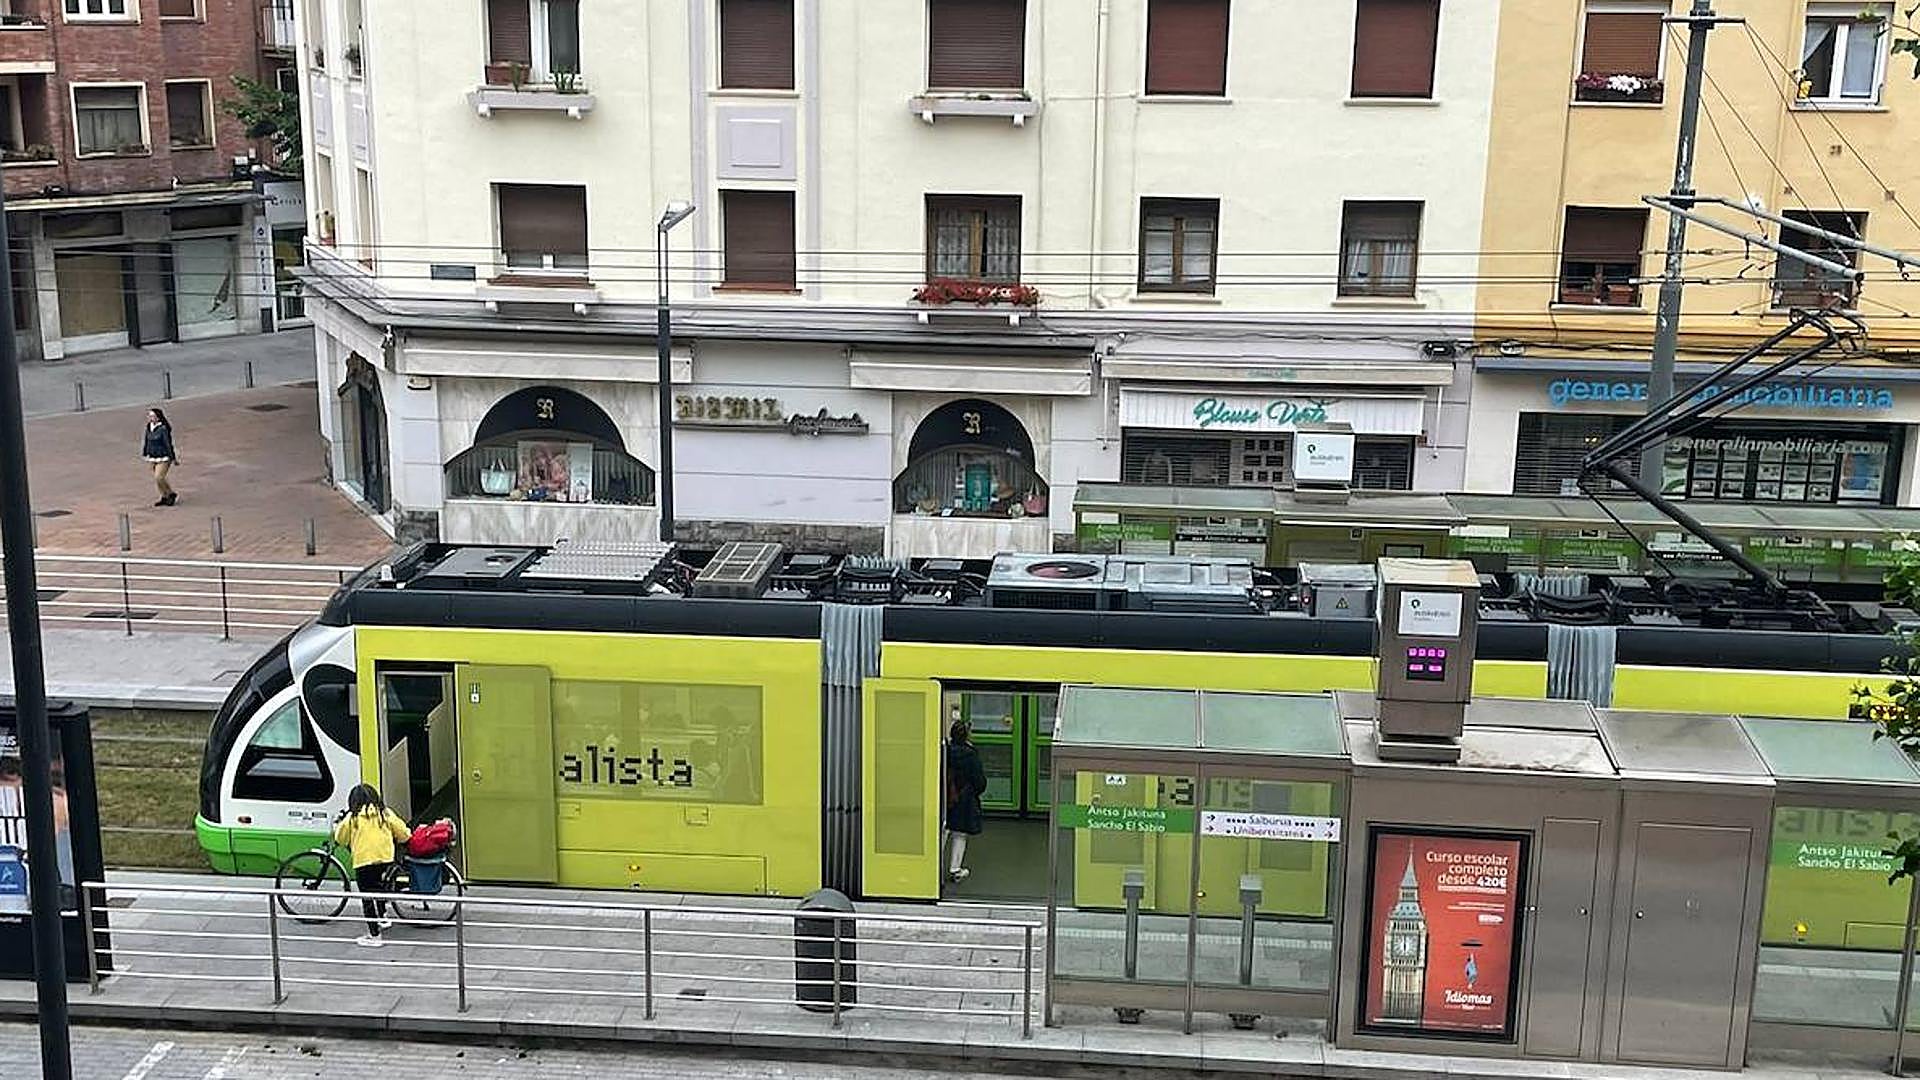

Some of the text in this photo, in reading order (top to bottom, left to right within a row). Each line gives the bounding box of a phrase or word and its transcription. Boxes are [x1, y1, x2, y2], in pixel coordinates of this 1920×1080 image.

[1550, 377, 1649, 406] gener
[560, 745, 692, 787] alista
[1088, 805, 1120, 816] Antso
[1088, 819, 1166, 832] Sancho El Sabio
[1799, 843, 1837, 856] Antso
[1426, 851, 1509, 866] Curso escolar
[1798, 856, 1892, 871] Sancho El Sabio
[1448, 864, 1508, 877] completo
[1437, 873, 1475, 885] desde
